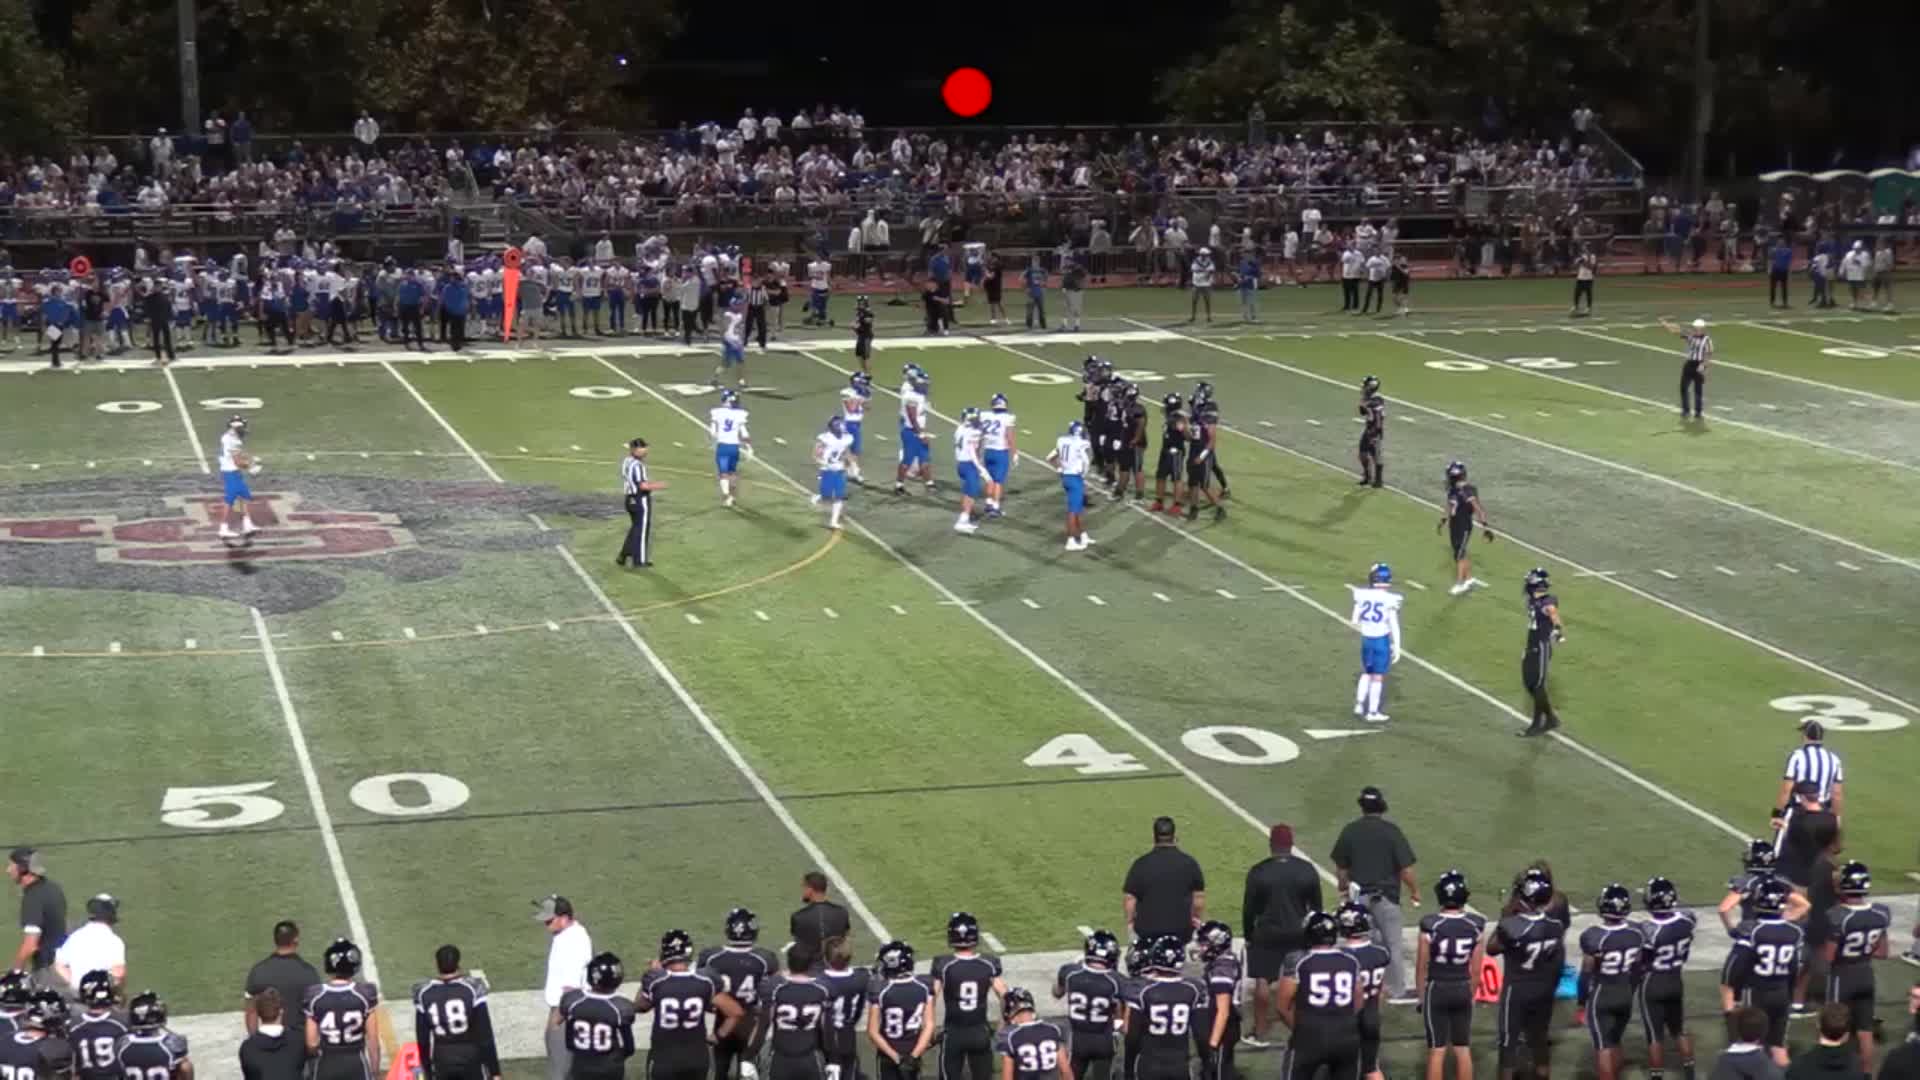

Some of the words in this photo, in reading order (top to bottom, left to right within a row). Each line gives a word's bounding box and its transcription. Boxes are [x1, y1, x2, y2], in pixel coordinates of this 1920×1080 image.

[1360, 600, 1384, 623] 25
[1768, 694, 1910, 731] 3
[1435, 937, 1474, 964] 15
[1753, 944, 1796, 976] 39
[958, 980, 979, 1012] 9
[1308, 970, 1353, 1007] 59
[427, 998, 469, 1036] 18
[659, 997, 704, 1029] 63
[776, 1003, 823, 1030] 27
[885, 1001, 924, 1039] 84
[1069, 991, 1110, 1023] 22
[319, 1009, 364, 1044] 42
[573, 1020, 613, 1051] 30
[79, 1036, 116, 1069] 19
